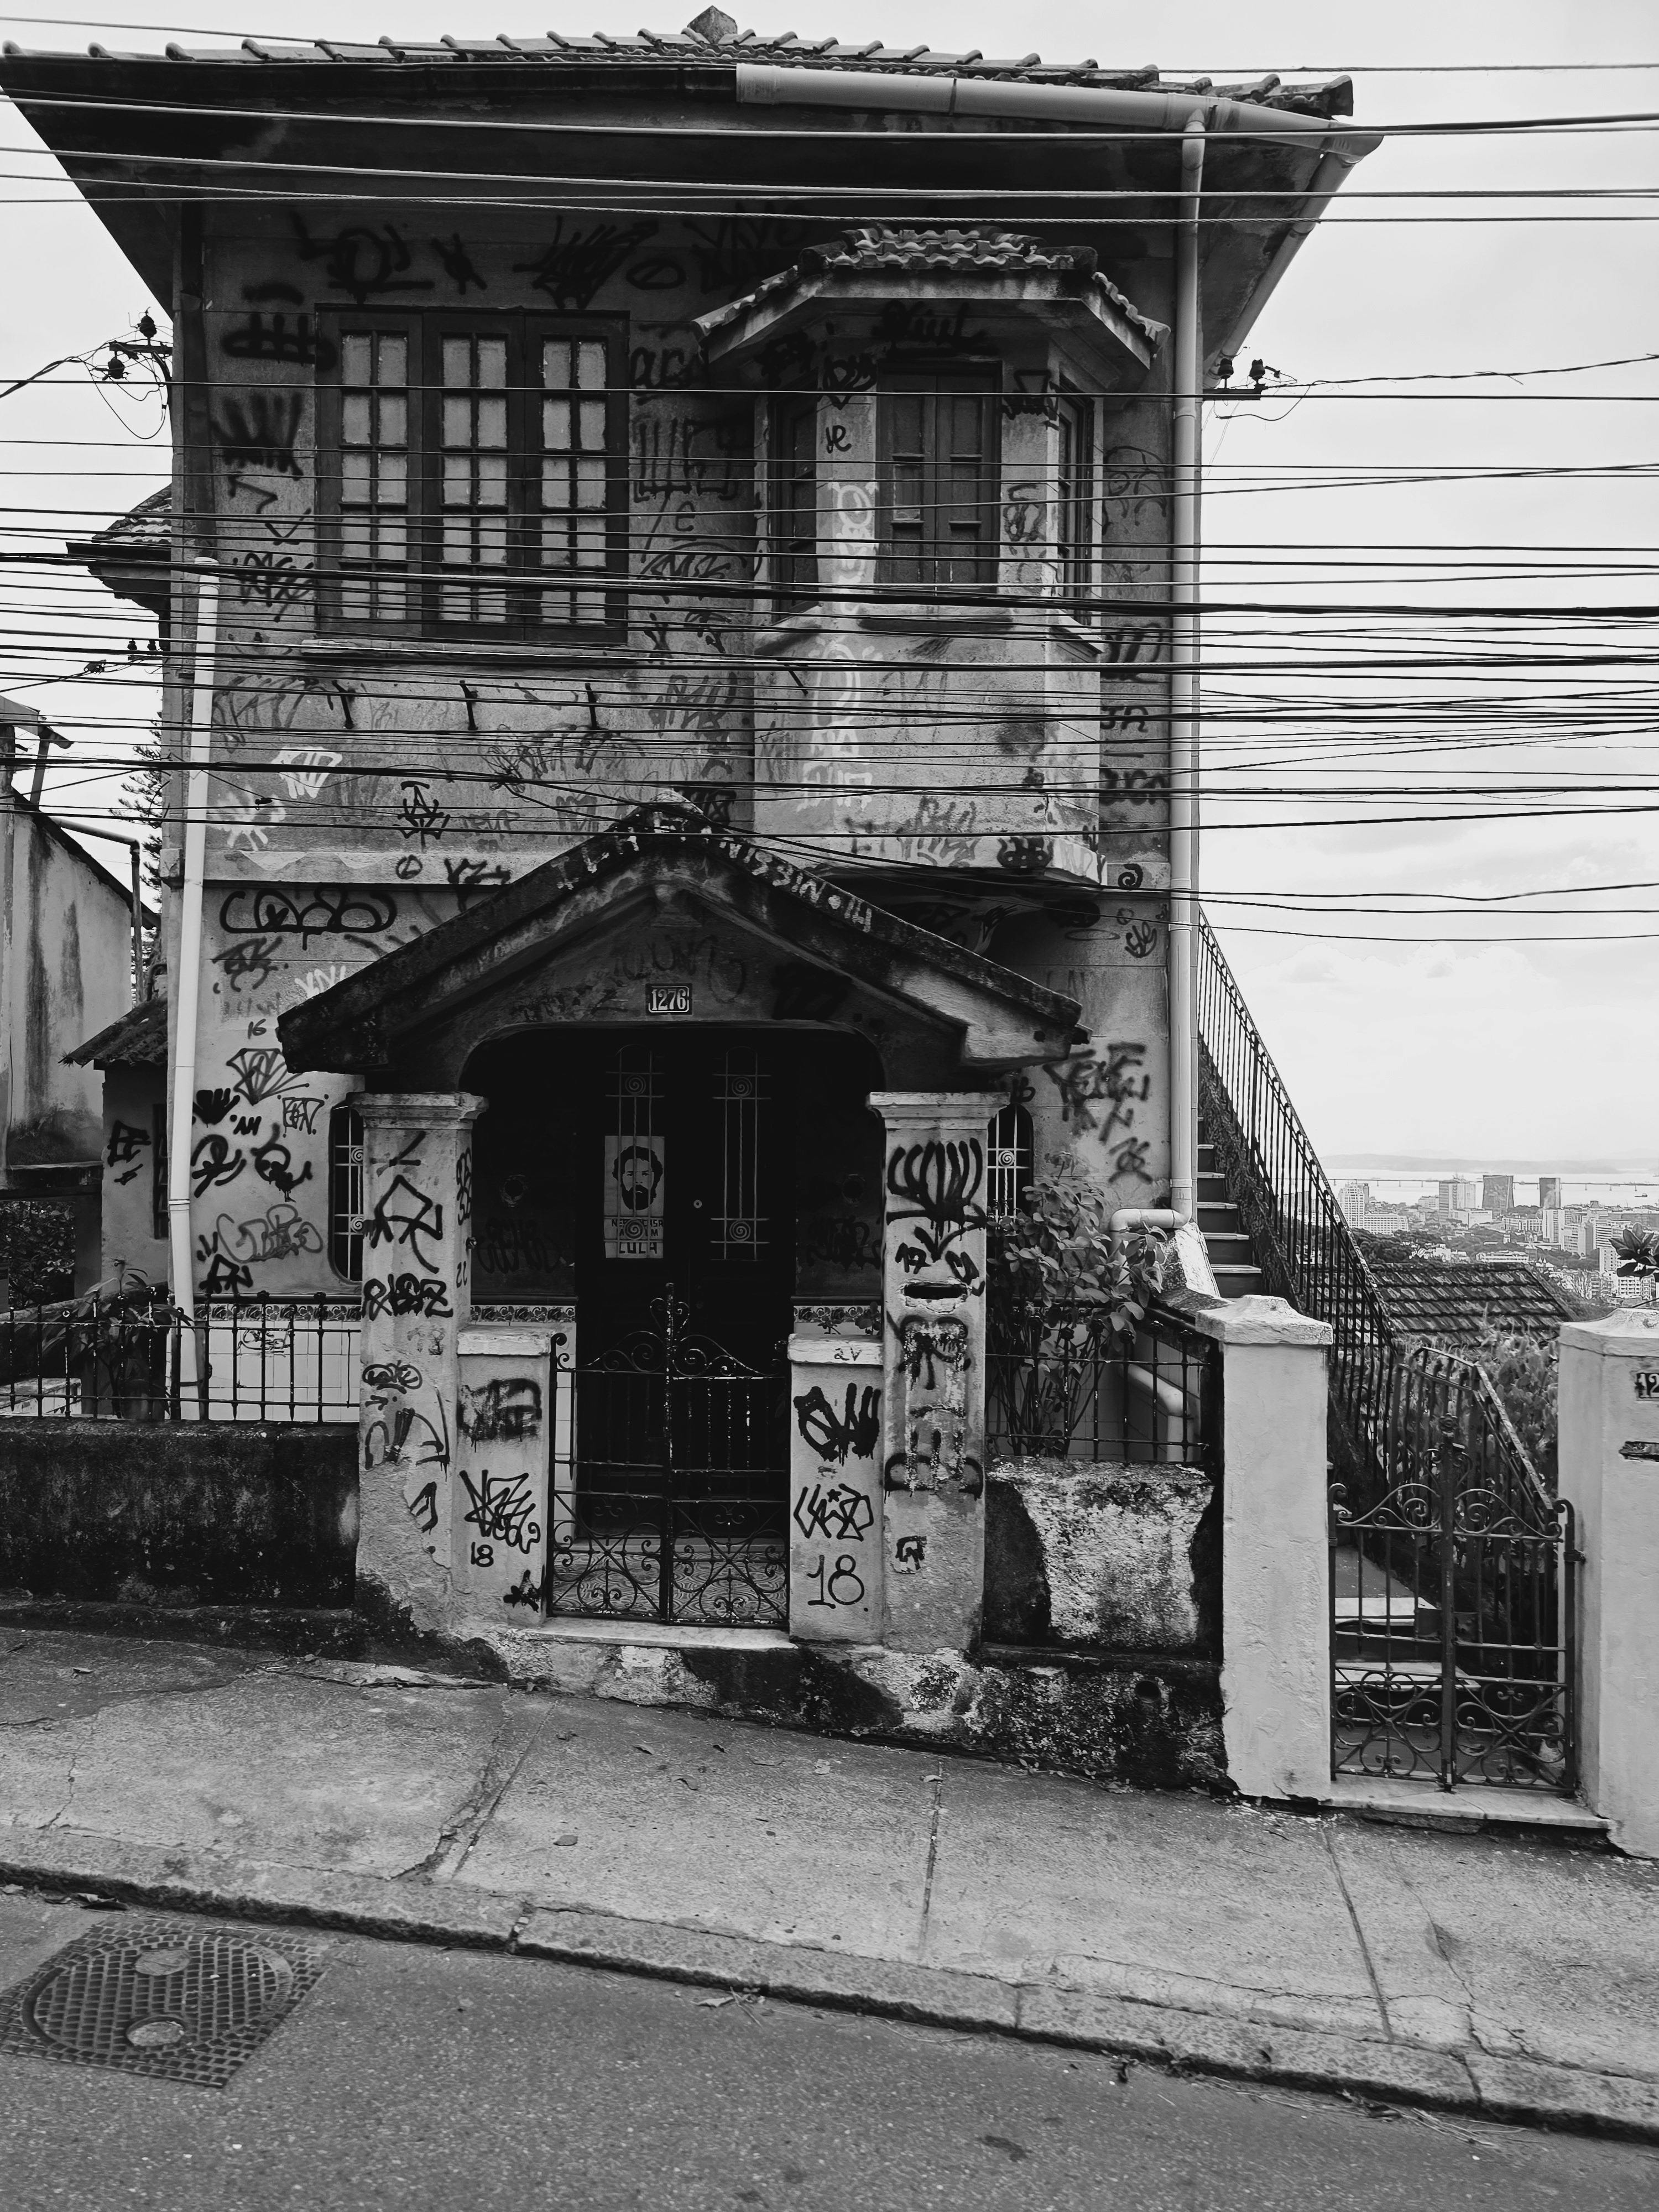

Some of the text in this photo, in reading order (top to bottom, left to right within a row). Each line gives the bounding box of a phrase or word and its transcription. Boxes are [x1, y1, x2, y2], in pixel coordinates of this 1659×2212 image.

[651, 988, 687, 1010] 1276
[619, 1242, 658, 1254] LULA
[471, 1542, 494, 1567] 18
